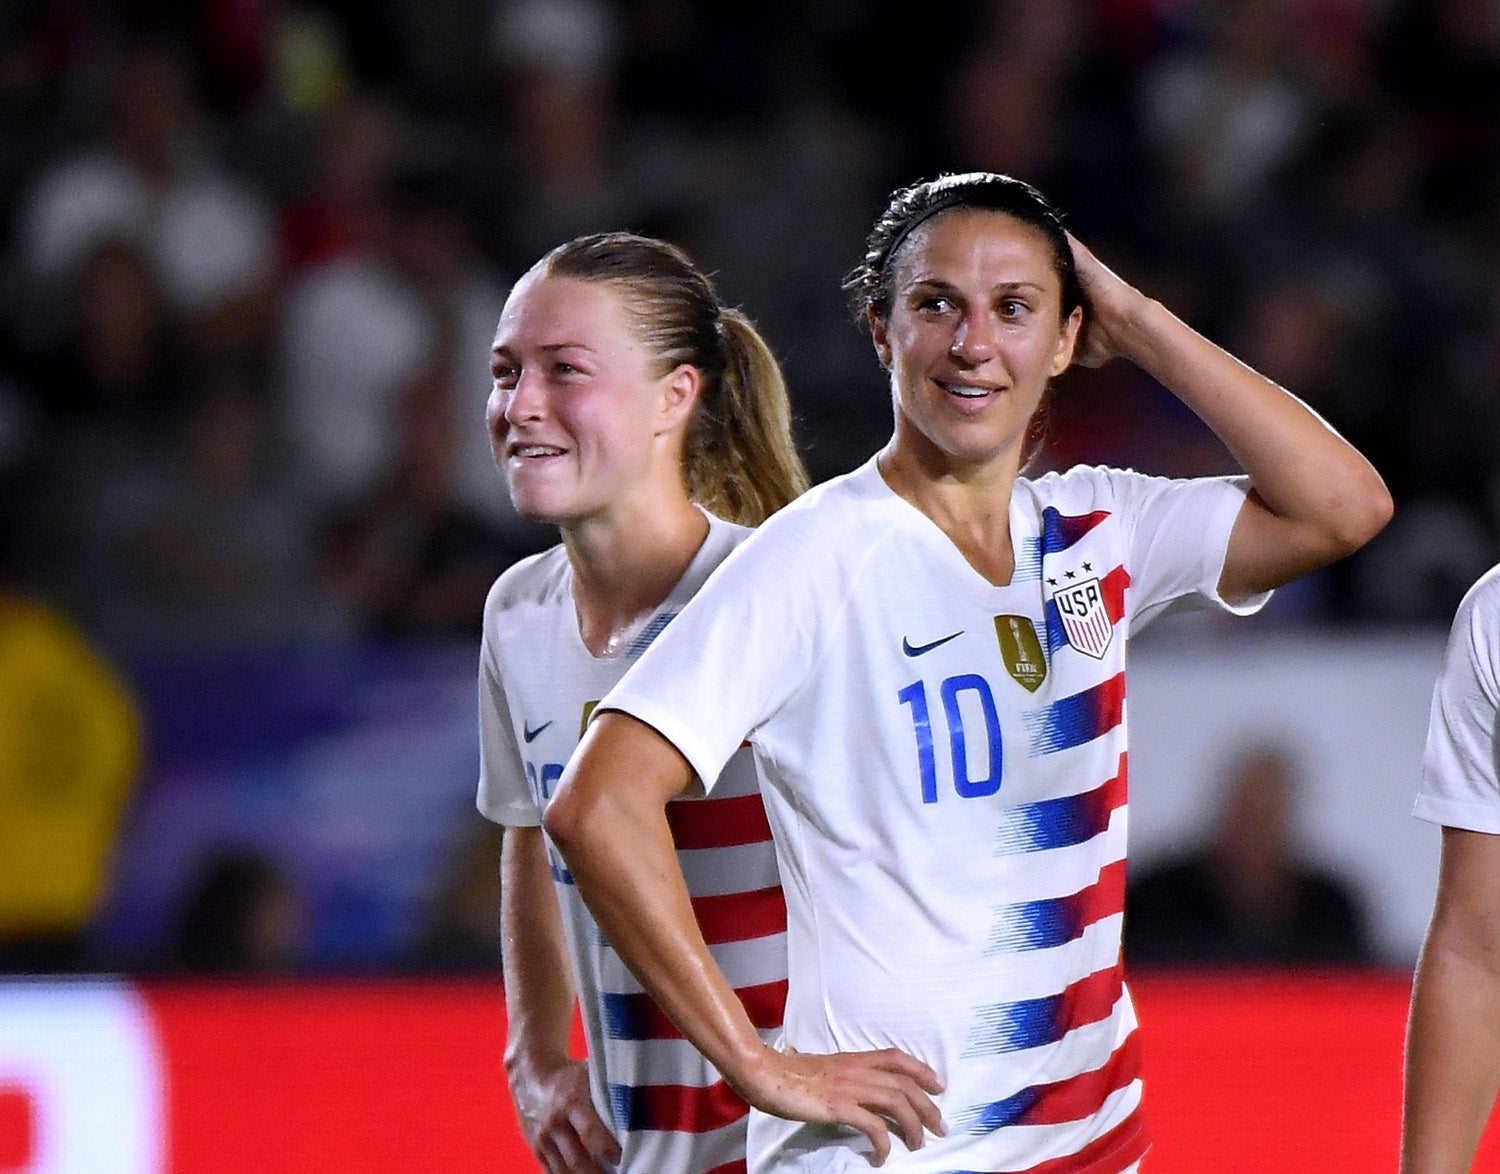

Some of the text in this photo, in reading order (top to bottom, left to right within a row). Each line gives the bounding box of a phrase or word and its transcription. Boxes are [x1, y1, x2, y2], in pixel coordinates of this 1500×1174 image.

[1058, 584, 1099, 617] USA
[1015, 662, 1038, 673] FIFA
[898, 673, 1002, 804] 10
